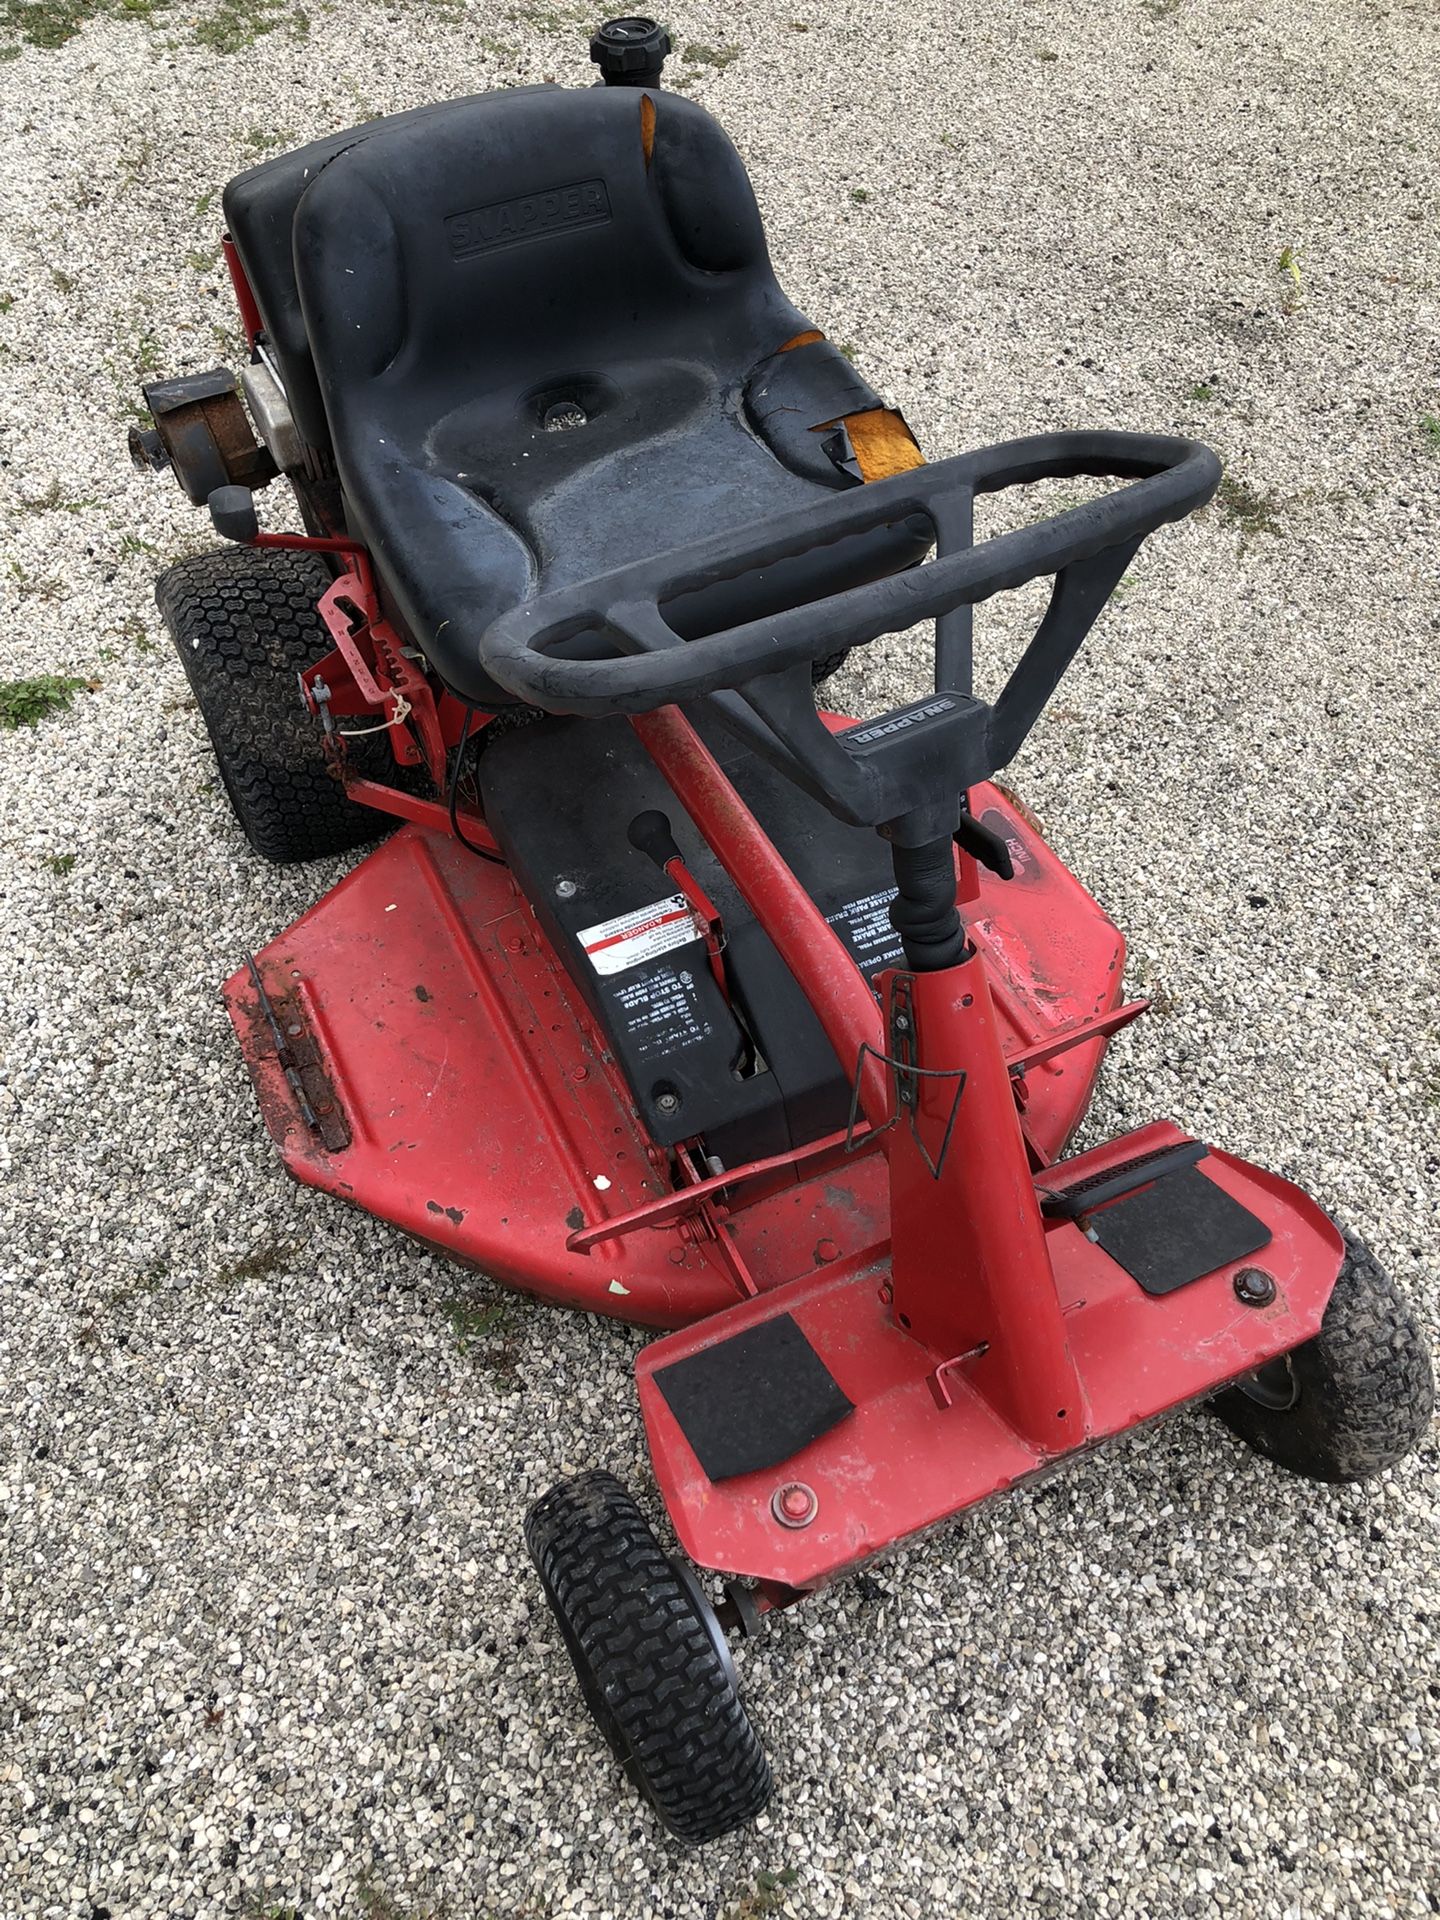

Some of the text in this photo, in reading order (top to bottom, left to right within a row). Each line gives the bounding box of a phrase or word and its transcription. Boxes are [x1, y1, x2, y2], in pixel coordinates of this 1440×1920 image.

[450, 184, 602, 247] SNAPPER
[854, 699, 956, 745] SNAPPER
[1005, 838, 1031, 861] INCH
[653, 907, 672, 918] Carbon
[848, 903, 868, 915] PARK
[619, 919, 656, 940] DANGER
[624, 915, 653, 930] monoxide
[603, 926, 623, 938] hazard
[851, 923, 892, 942] ARK BRAKE
[625, 936, 686, 966] Before starting engine
[649, 986, 670, 999] STOP
[671, 981, 682, 990] TO
[623, 994, 648, 1008] BLADE
